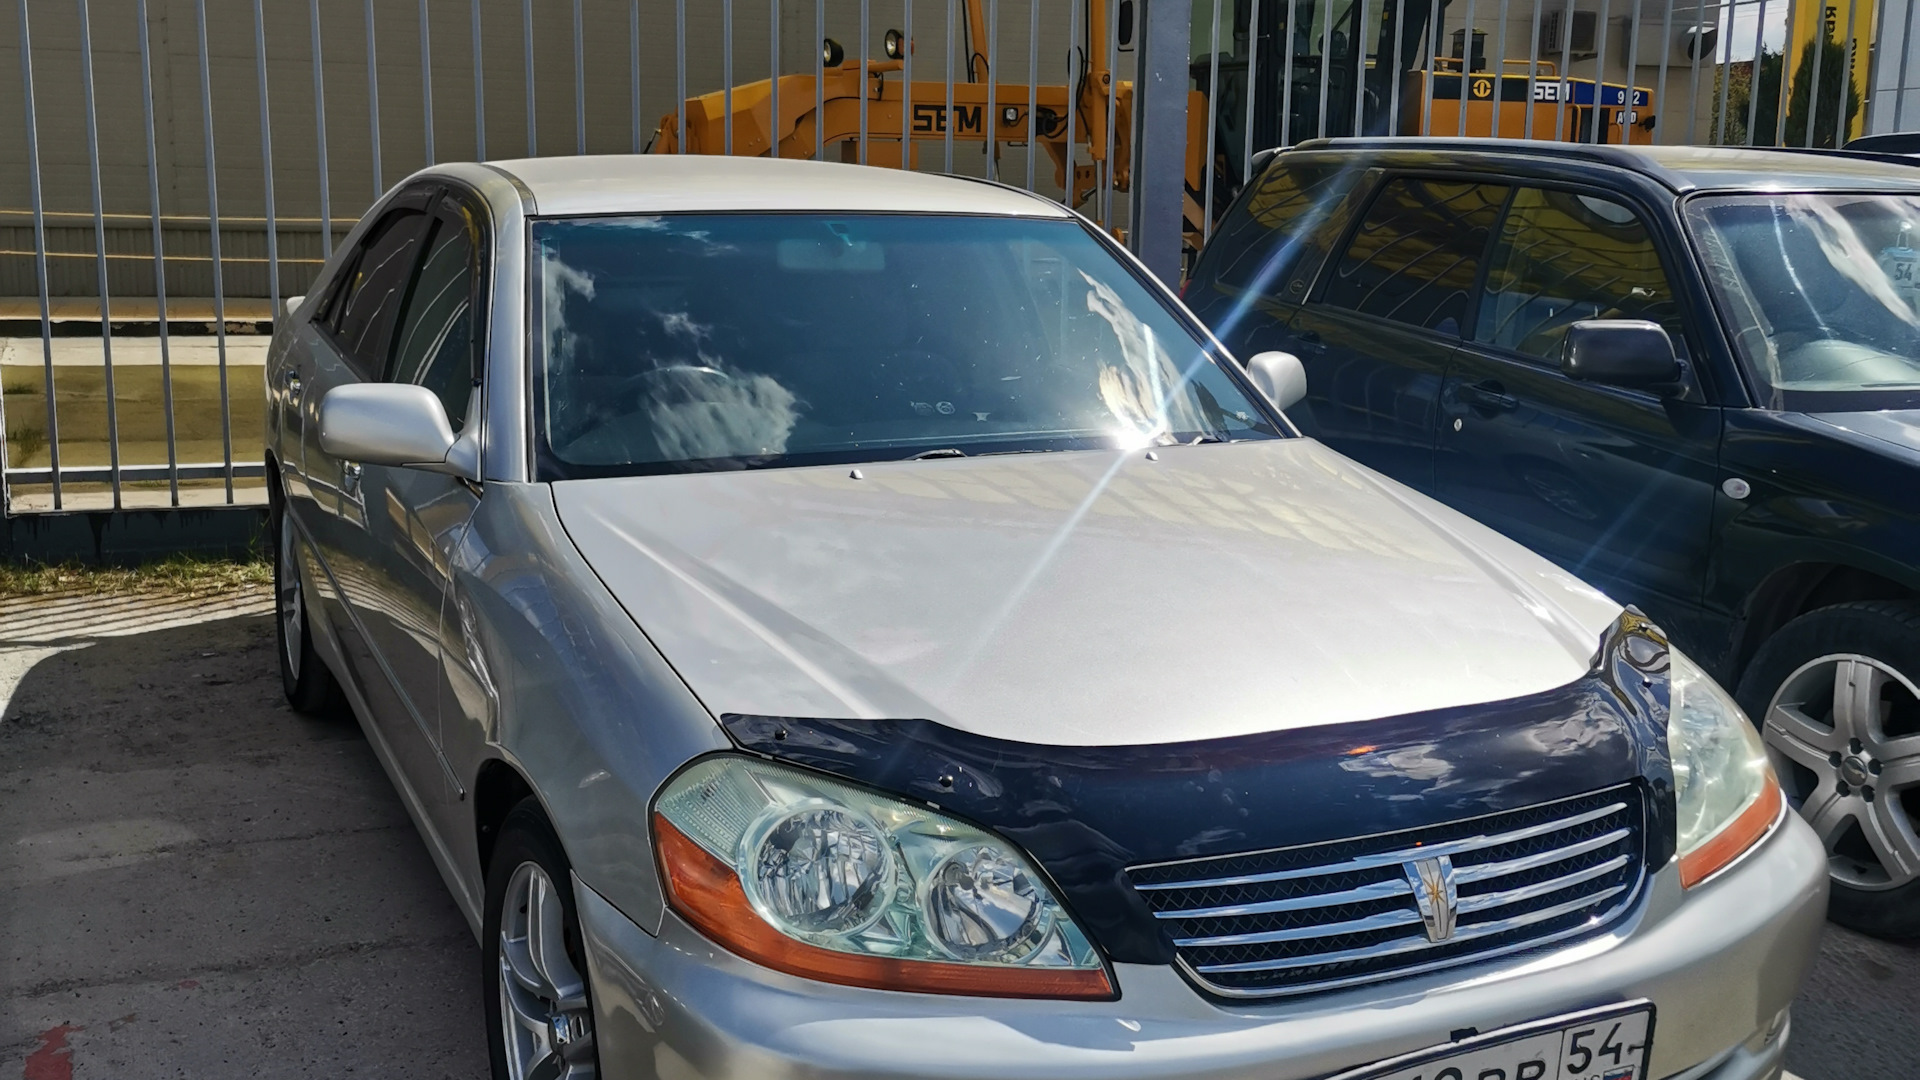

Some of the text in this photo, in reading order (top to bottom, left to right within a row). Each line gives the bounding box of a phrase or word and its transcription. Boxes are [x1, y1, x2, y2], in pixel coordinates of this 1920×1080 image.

[1617, 90, 1641, 105] 92
[913, 105, 981, 133] SEM
[1616, 111, 1637, 123] AD
[1895, 263, 1913, 281] 54
[1567, 1022, 1622, 1074] 54
